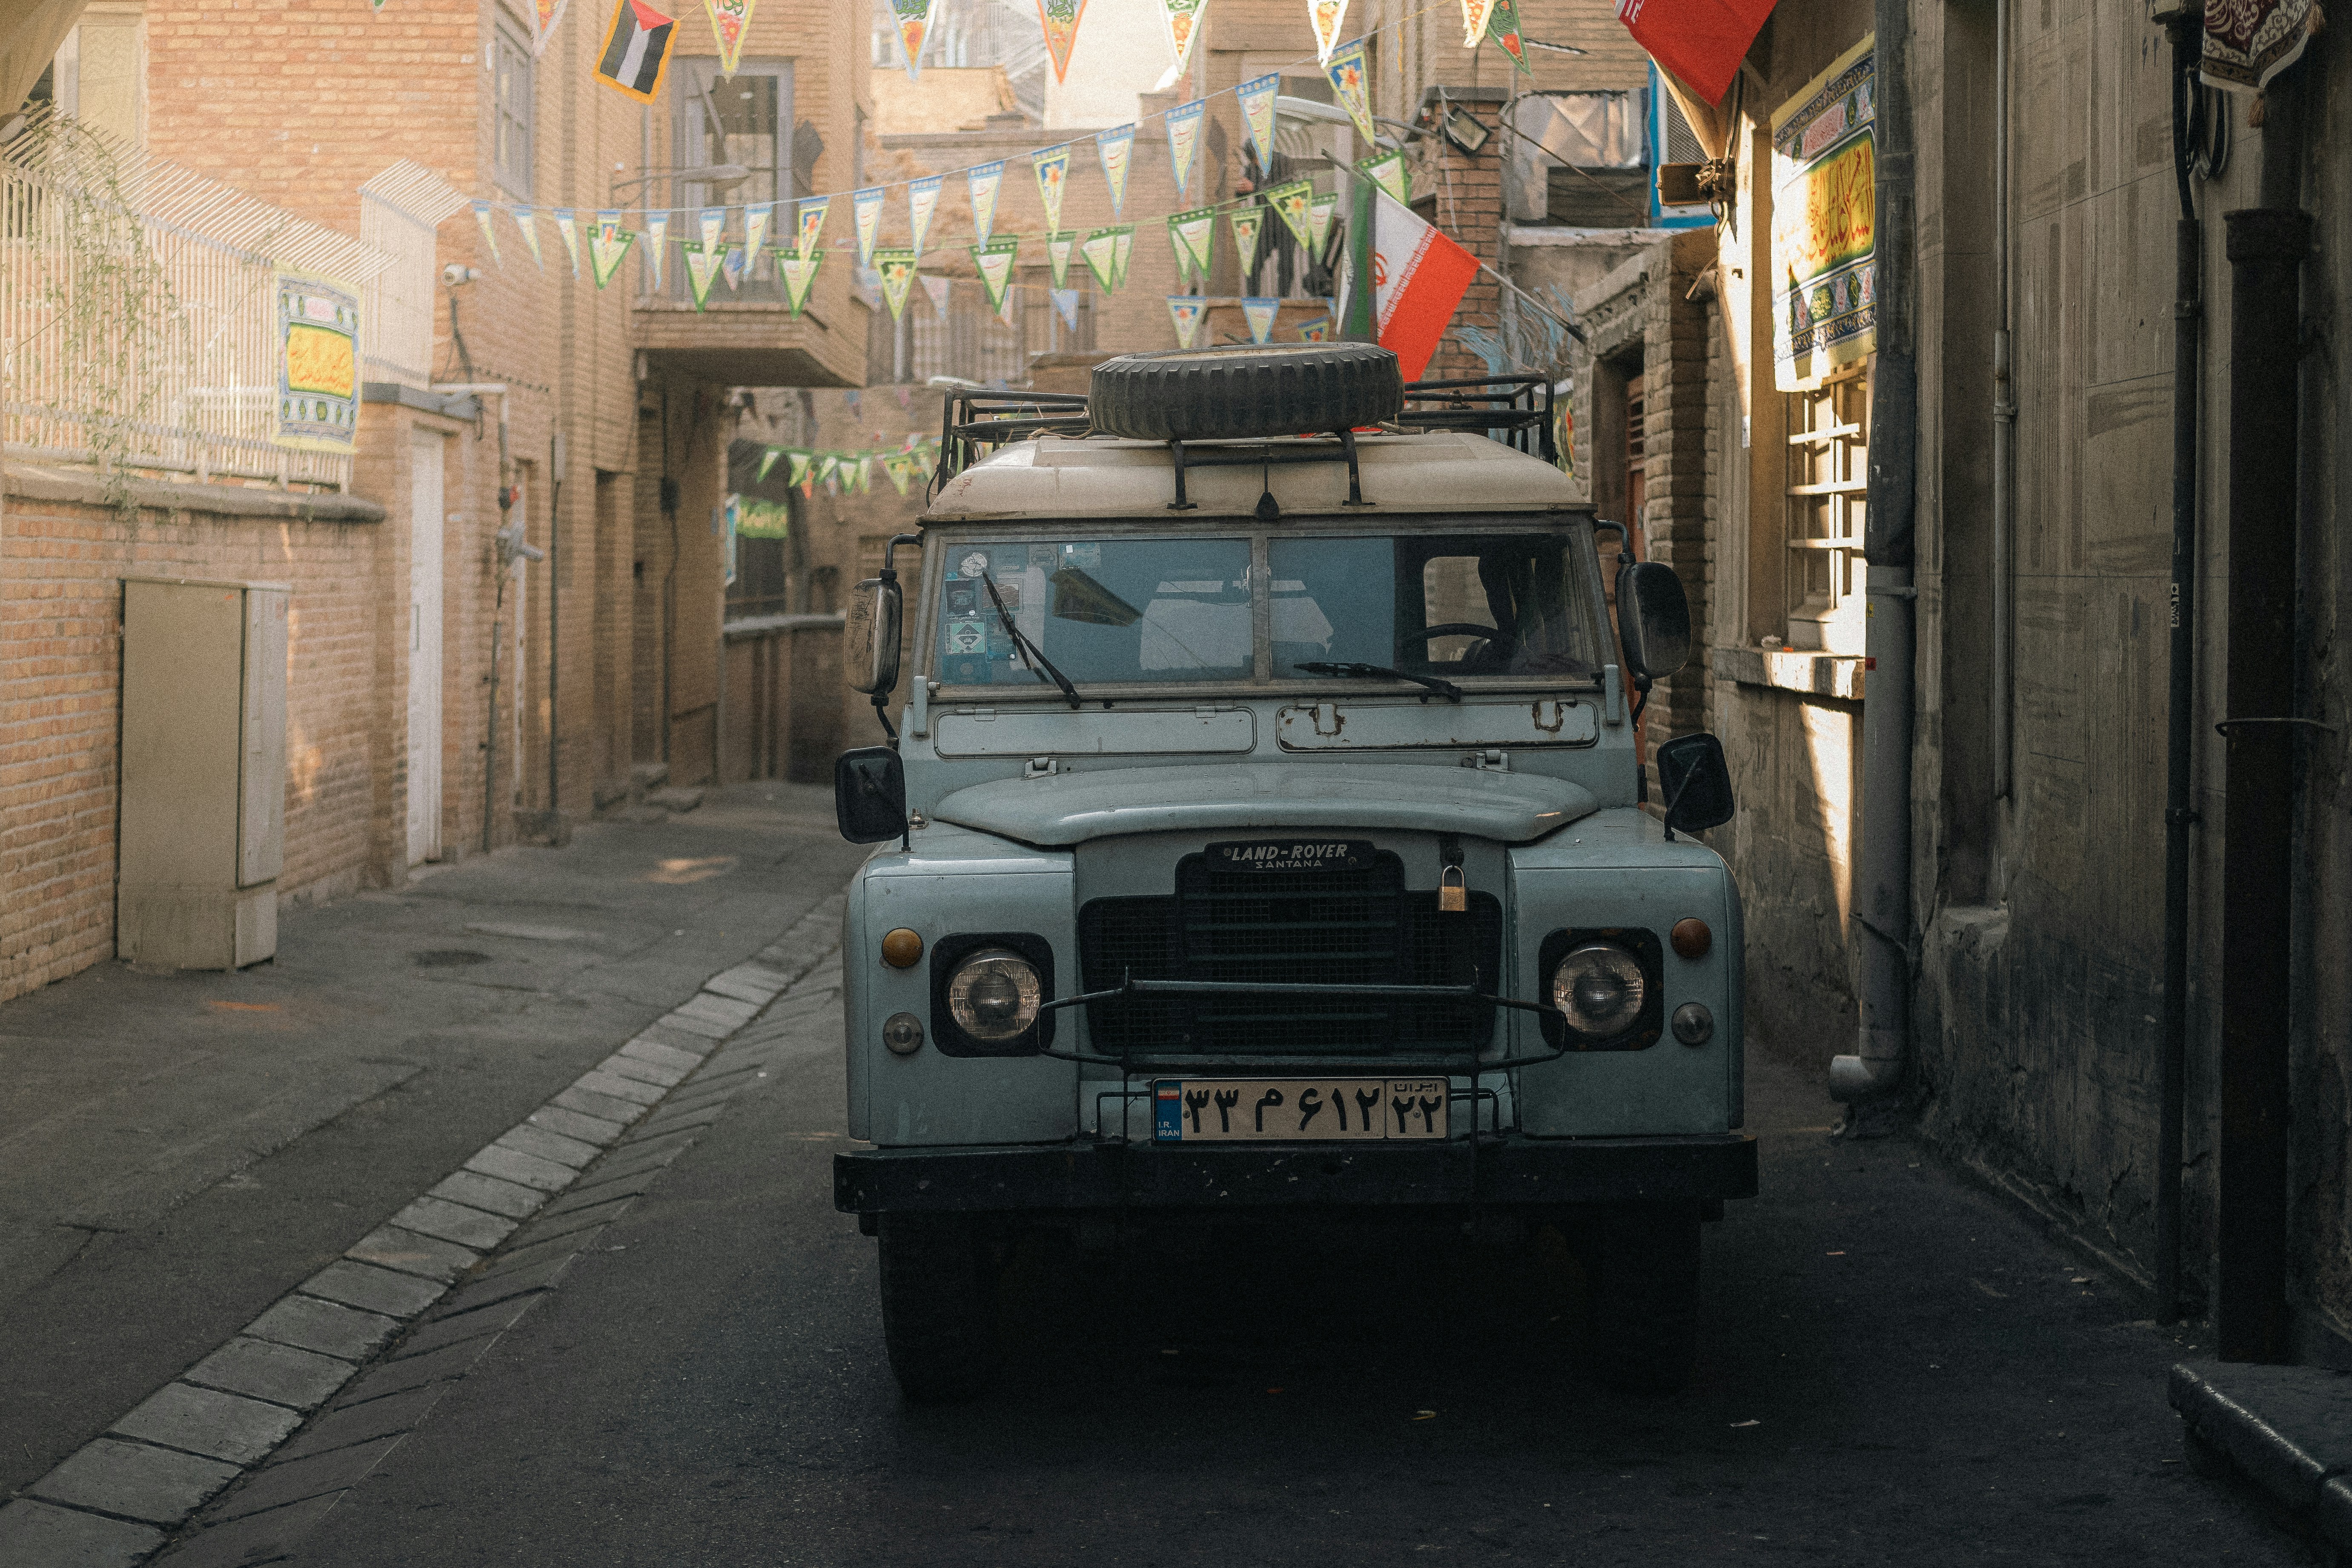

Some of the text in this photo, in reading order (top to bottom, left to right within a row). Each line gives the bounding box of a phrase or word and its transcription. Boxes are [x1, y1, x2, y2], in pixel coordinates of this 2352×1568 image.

[1232, 844, 1348, 861] LAND-ROVER
[1255, 860, 1323, 869] SANTANA
[1394, 1083, 1438, 1092] ایران
[1391, 1094, 1442, 1134] ۲۲
